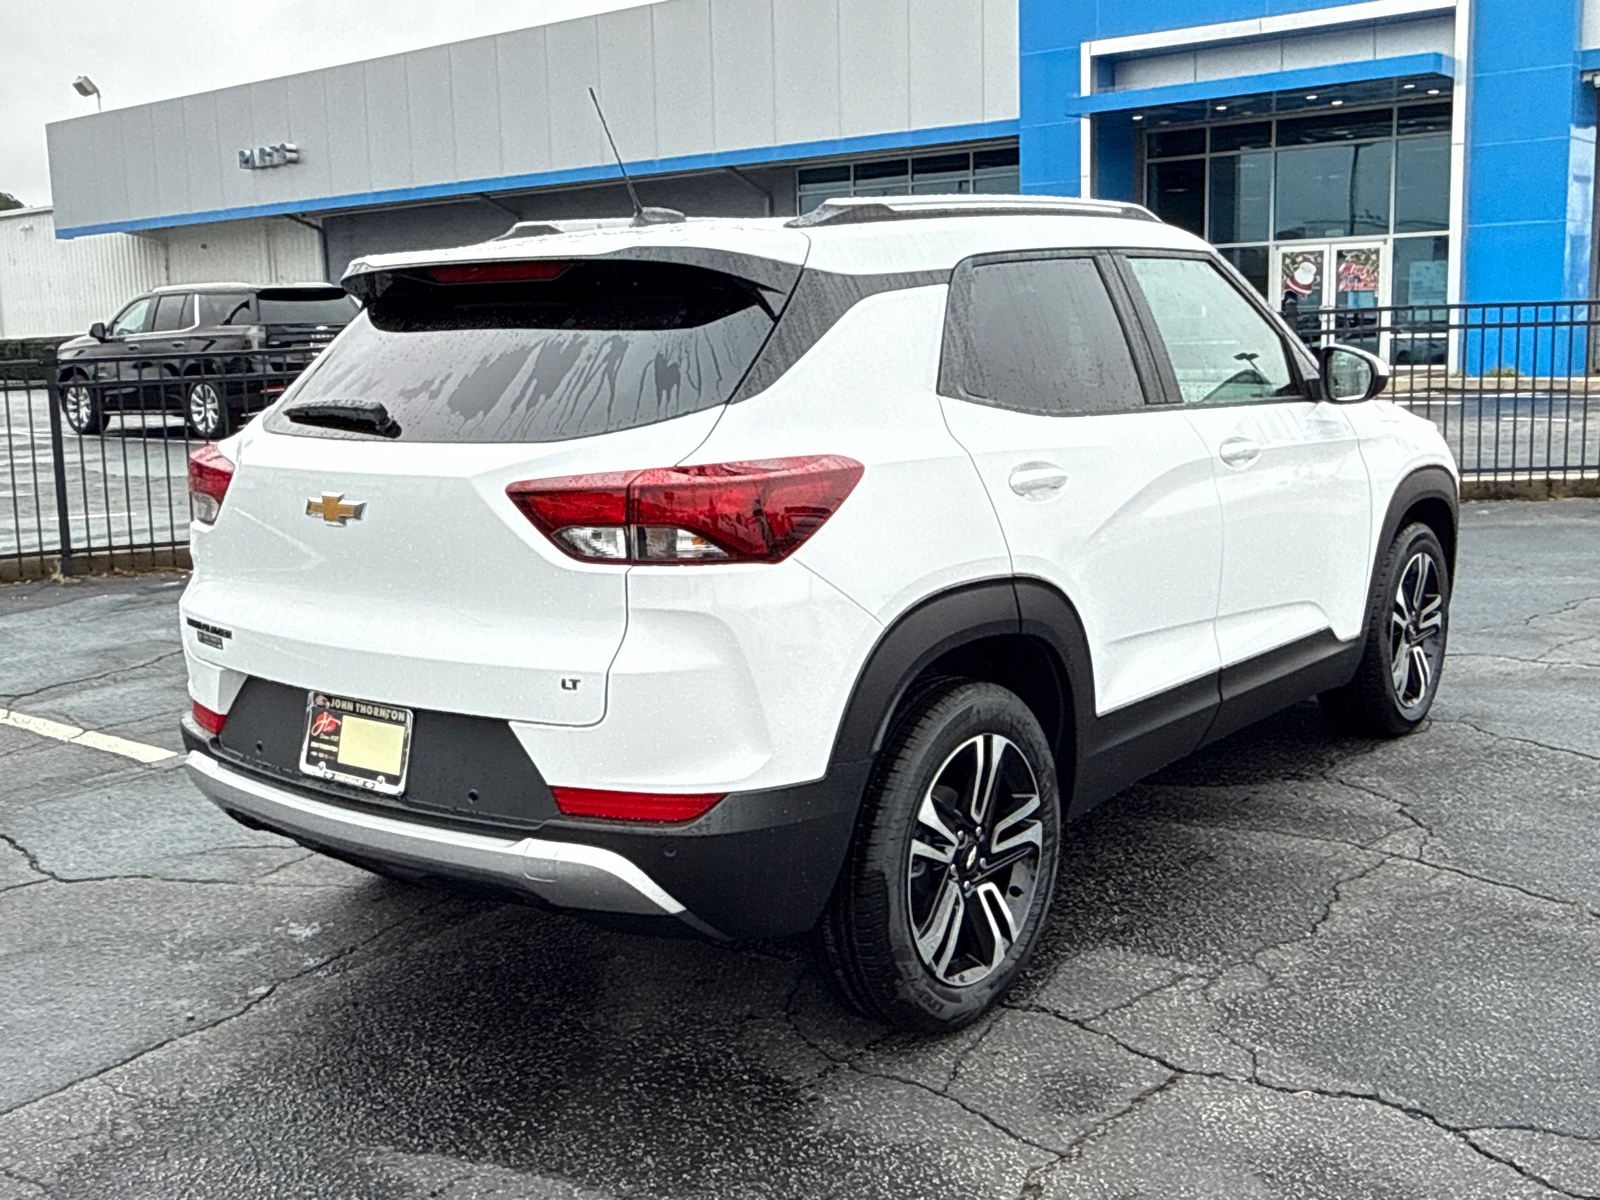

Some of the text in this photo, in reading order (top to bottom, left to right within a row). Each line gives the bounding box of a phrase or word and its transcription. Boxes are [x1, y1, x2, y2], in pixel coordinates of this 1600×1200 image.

[561, 678, 581, 690] LT
[331, 698, 405, 722] JOHN THORNTON
